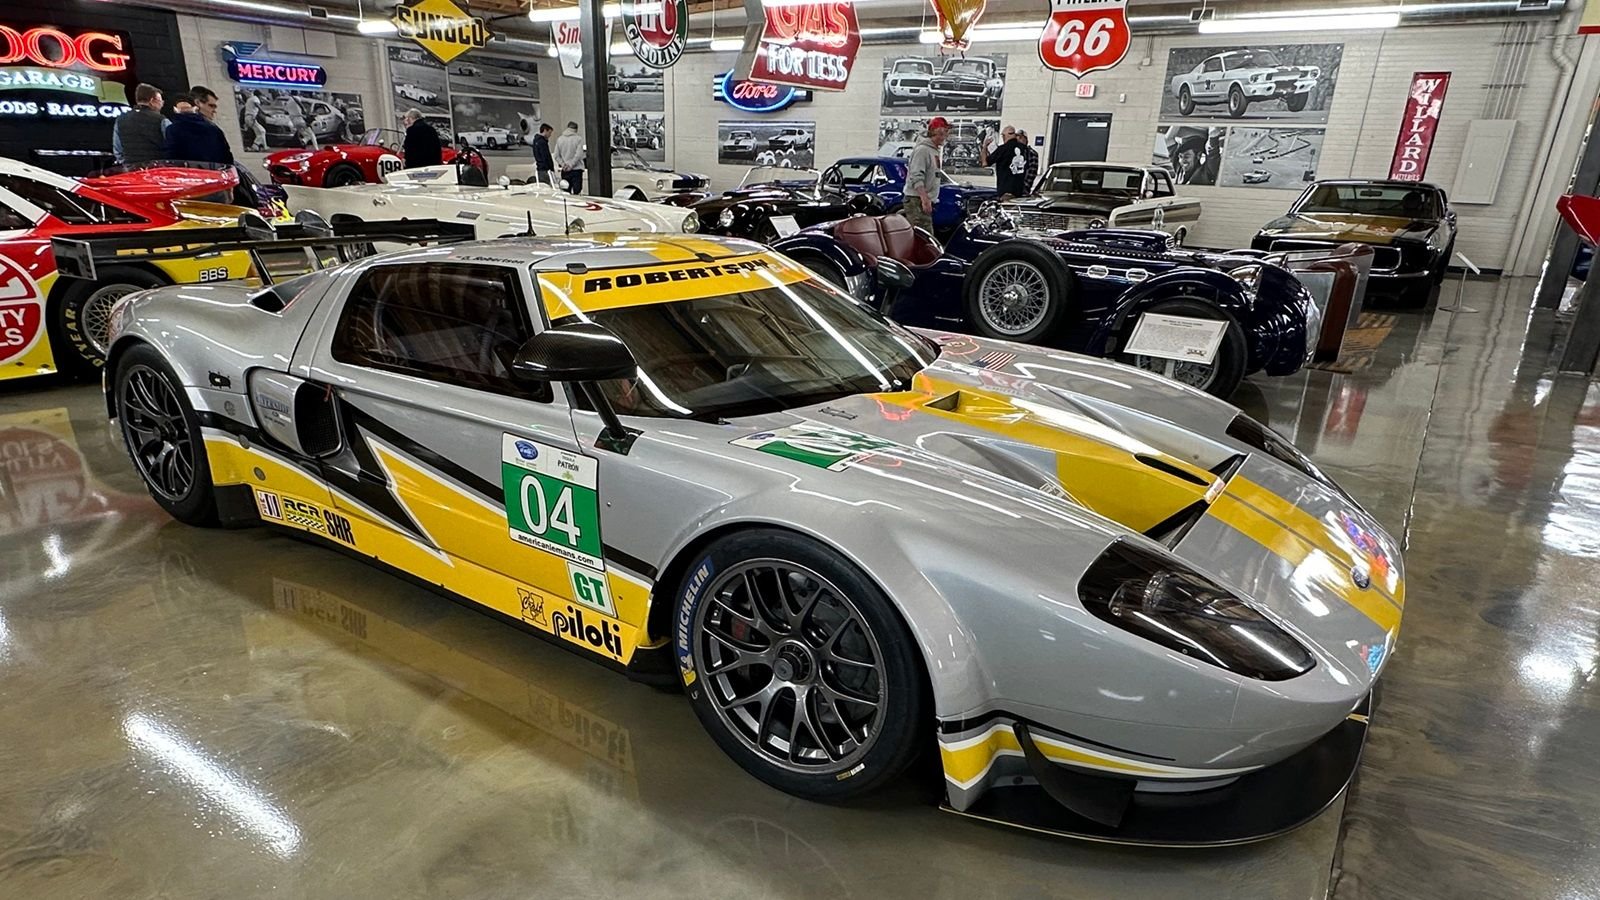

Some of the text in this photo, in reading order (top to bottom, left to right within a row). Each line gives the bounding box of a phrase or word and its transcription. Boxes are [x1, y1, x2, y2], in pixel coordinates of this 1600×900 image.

[398, 6, 484, 46] SUNOCO
[627, 23, 684, 65] GASOLINE
[1054, 17, 1115, 57] 66
[0, 70, 96, 91] GARAGE
[238, 62, 318, 83] MERCURY
[767, 43, 848, 82] FOR LESS
[1079, 84, 1092, 96] EXIT
[0, 101, 38, 114] ODS
[47, 103, 99, 117] RACE
[1399, 78, 1442, 173] WILLARD
[378, 159, 402, 177] 198
[200, 267, 228, 282] BBS
[583, 259, 770, 293] ROBERTSON
[283, 498, 320, 518] RCR
[520, 474, 582, 547] 04
[323, 509, 356, 546] SHR
[518, 534, 594, 566] americanlemans.com
[573, 571, 606, 607] GT
[677, 563, 710, 652] MICHELIN
[552, 605, 623, 657] piloti
